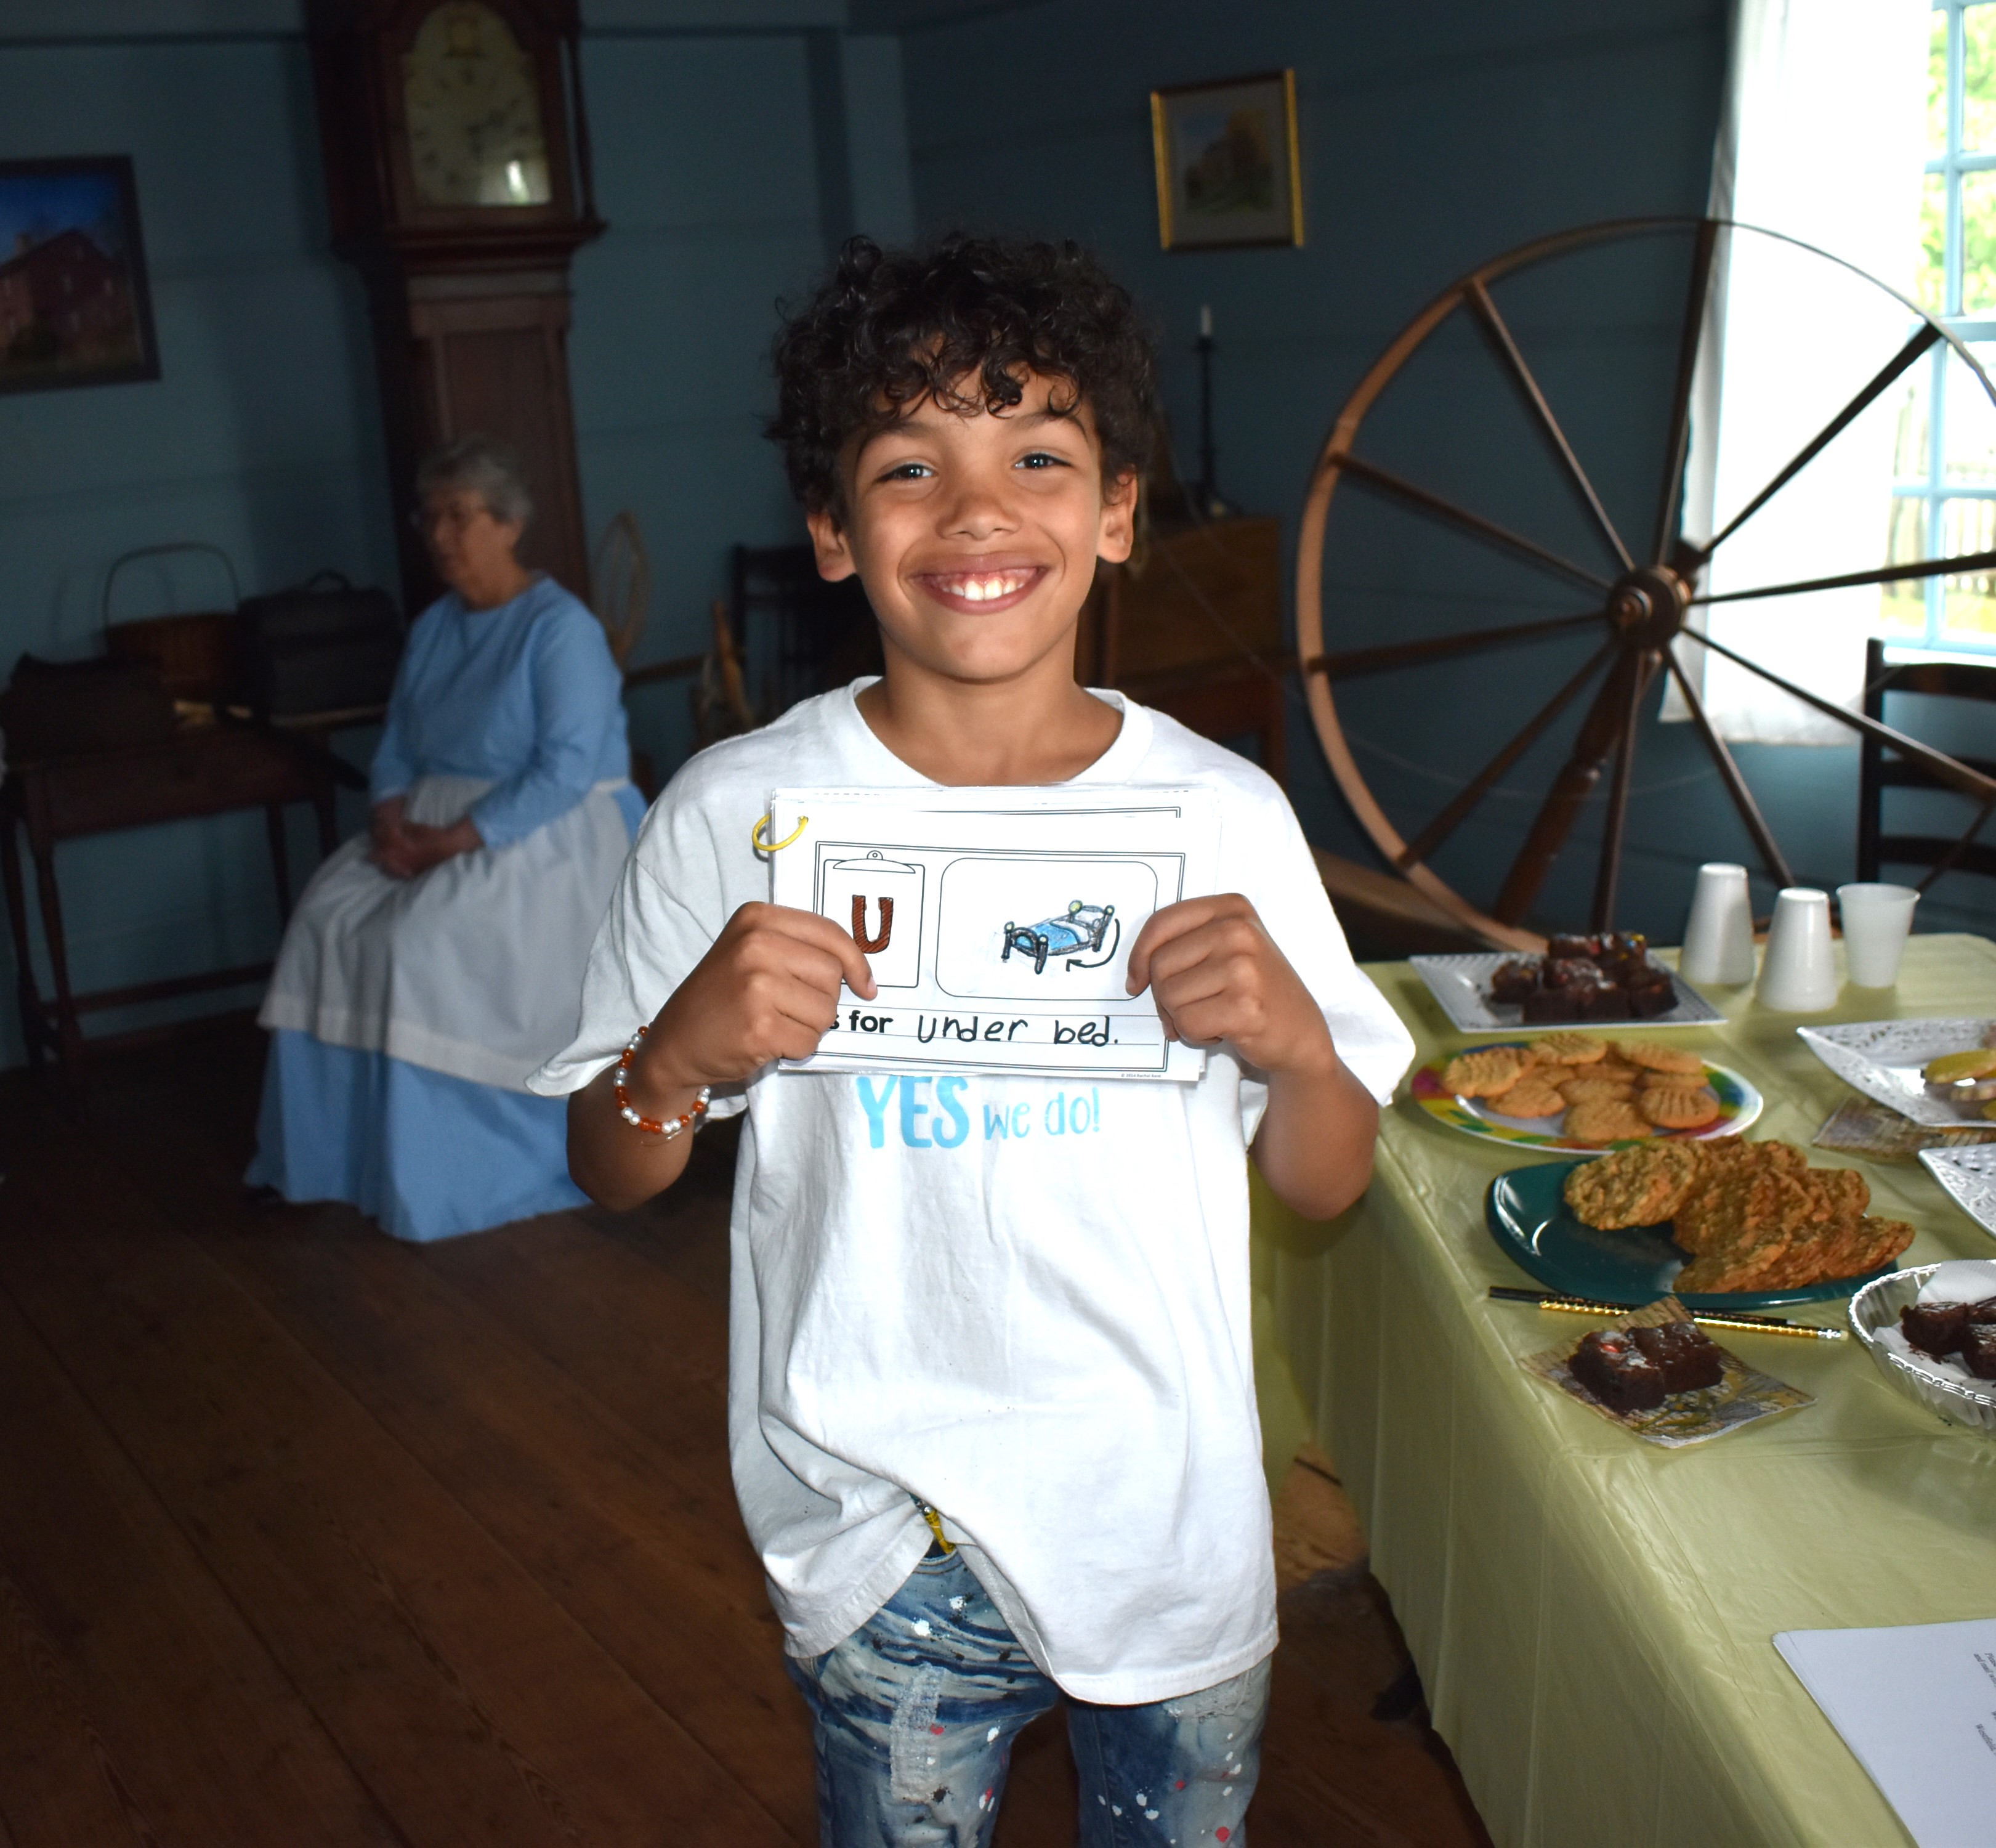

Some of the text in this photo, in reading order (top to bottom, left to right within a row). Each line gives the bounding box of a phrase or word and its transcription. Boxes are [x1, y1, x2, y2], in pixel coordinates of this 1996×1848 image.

[852, 894, 894, 954] U
[849, 1010, 894, 1033] for
[1054, 1015, 1118, 1047] bed.
[856, 1076, 1101, 1149] YES we do!
